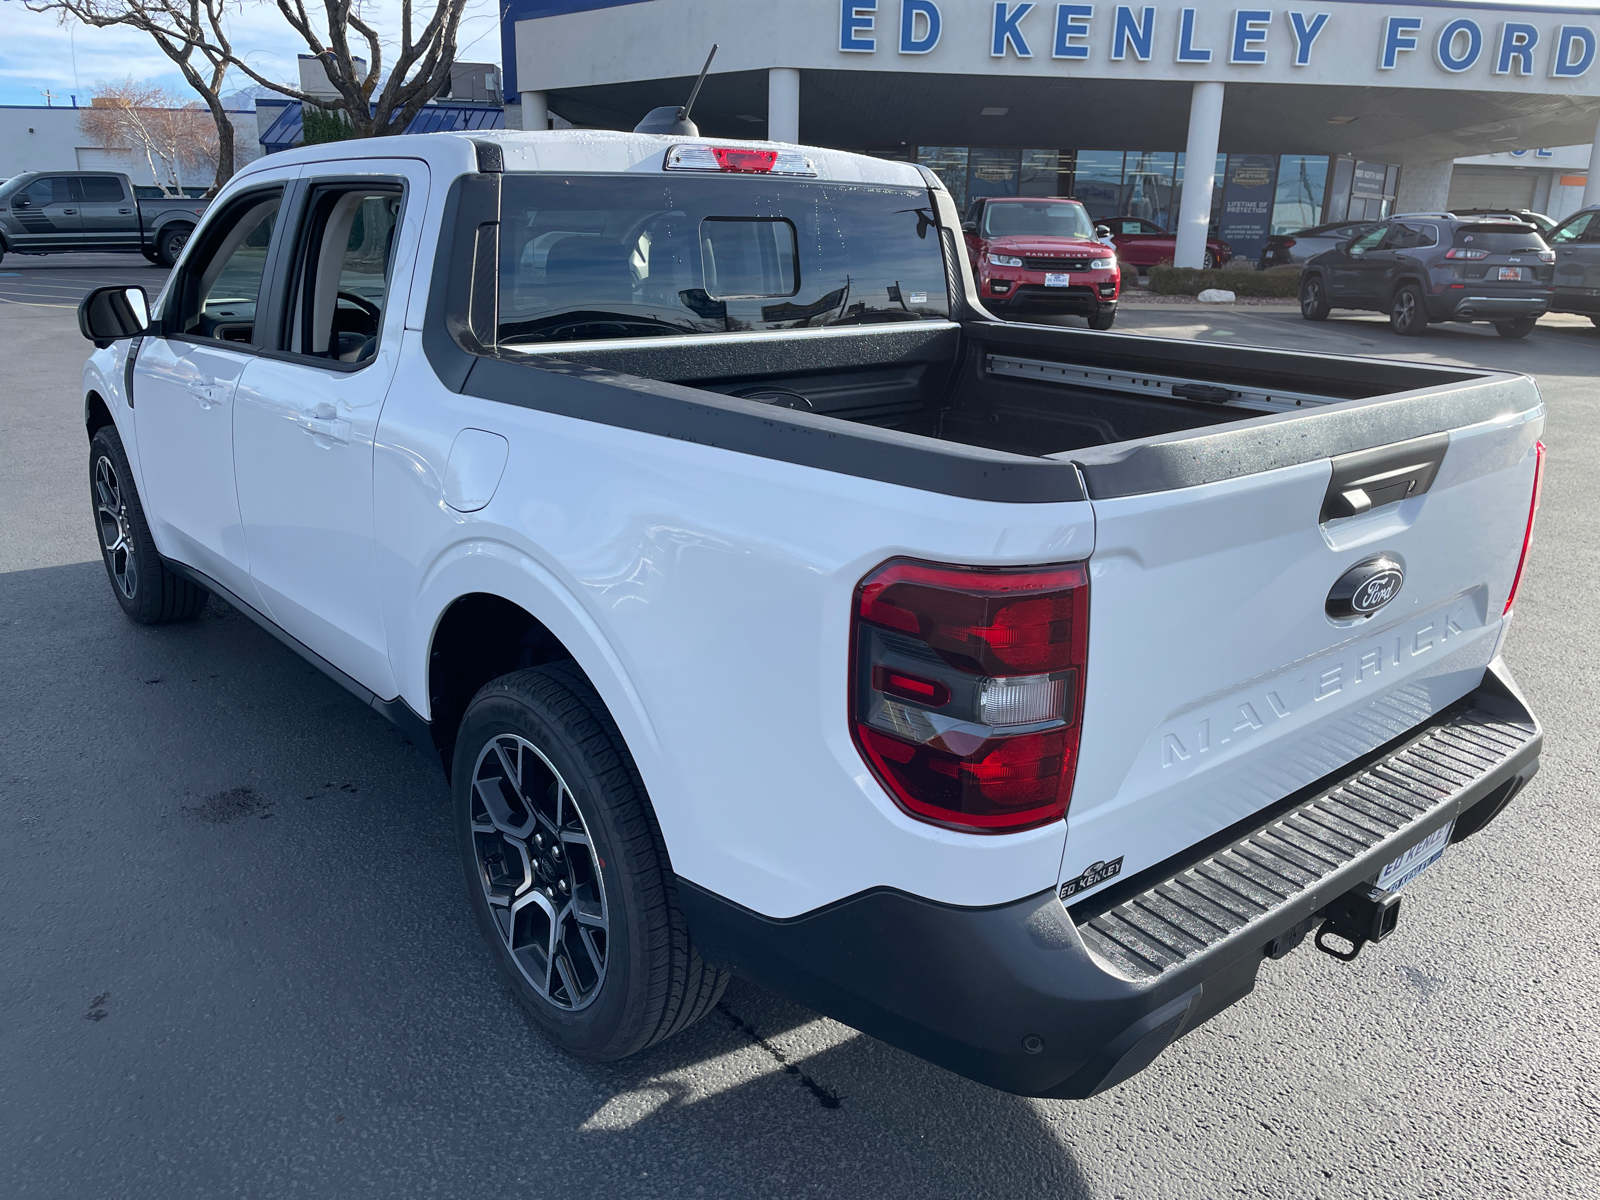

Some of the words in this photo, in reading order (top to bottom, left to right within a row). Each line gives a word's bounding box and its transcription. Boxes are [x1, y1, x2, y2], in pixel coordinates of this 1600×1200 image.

[839, 0, 943, 55] ED
[990, 1, 1332, 67] KENLEY
[1377, 15, 1597, 78] FORD
[1362, 577, 1395, 608] Ford
[1161, 606, 1466, 769] MAVERICK
[1384, 853, 1405, 877] ED
[1405, 821, 1451, 864] KENLEY
[1060, 883, 1076, 899] ED
[1078, 861, 1122, 890] KENLEY
